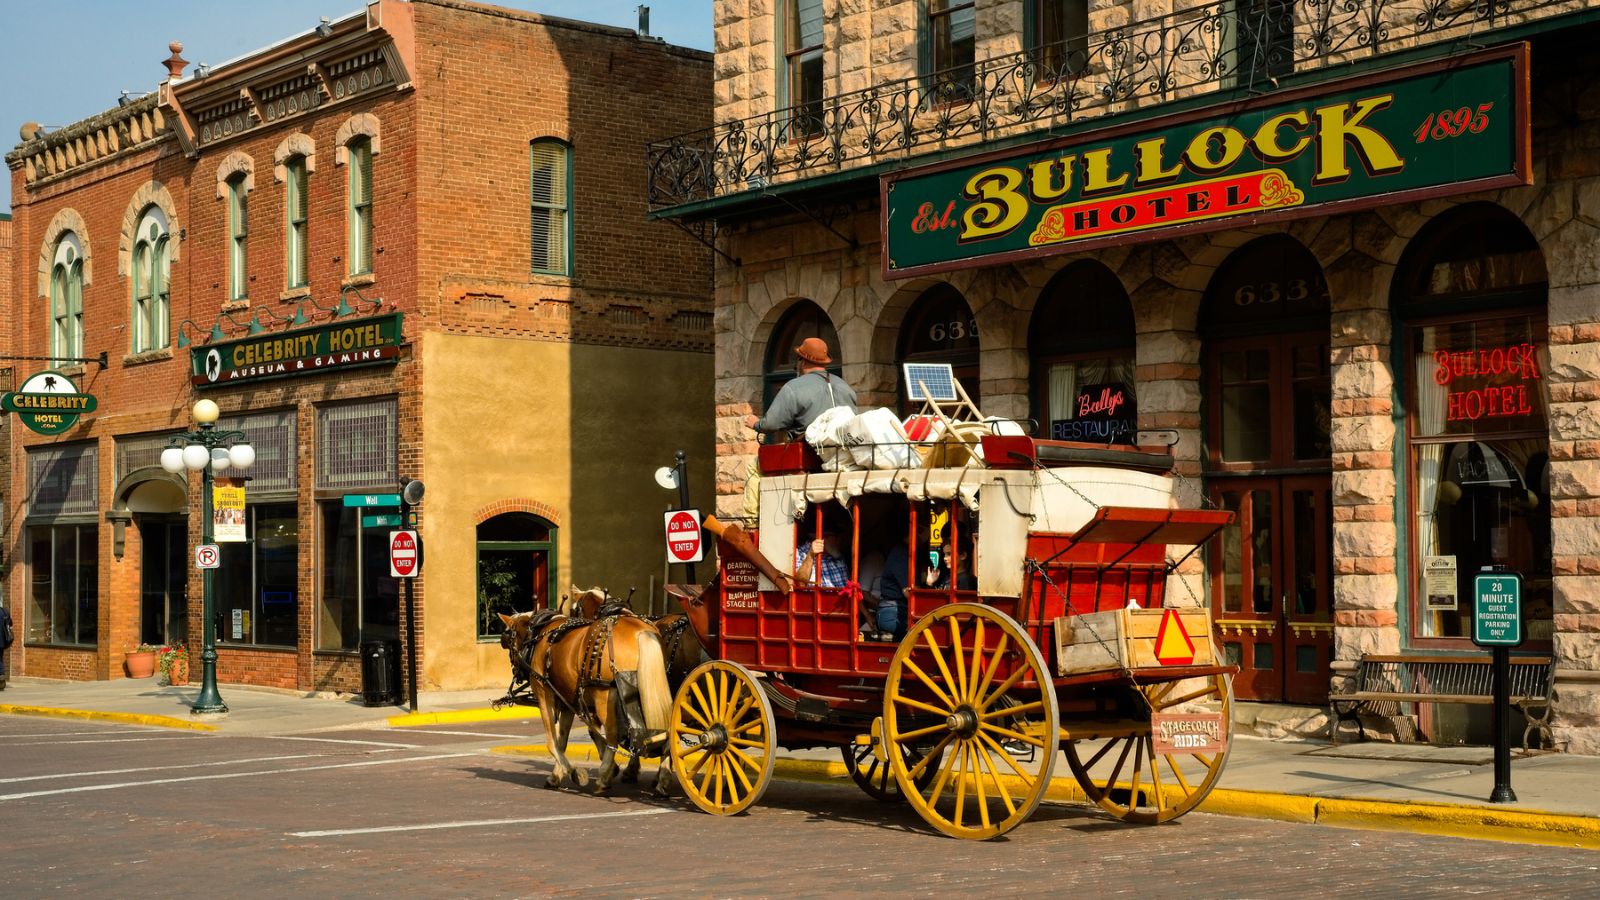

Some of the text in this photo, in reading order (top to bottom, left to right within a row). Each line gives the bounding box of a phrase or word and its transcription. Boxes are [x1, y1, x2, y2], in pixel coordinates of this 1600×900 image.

[911, 94, 1494, 246] Est. BULLOCK 1895
[1073, 185, 1250, 231] HOTEL
[233, 333, 320, 367] CELEBRITY
[330, 324, 384, 352] HOTEL
[230, 349, 381, 379] MUSEUM & GAMING
[1432, 343, 1540, 385] BULLOCK
[12, 394, 88, 409] CELEBRITY
[1447, 385, 1532, 420] HOTEL
[34, 414, 63, 423] HOTEL
[365, 496, 378, 505] Wall
[670, 521, 694, 530] DO NOT
[675, 543, 694, 551] ENTER
[1492, 582, 1503, 592] 20
[728, 591, 758, 600] BLACK HILLS
[1481, 594, 1514, 603] MINUTE
[726, 600, 746, 608] STAGE
[1160, 720, 1220, 742] STAGECOACH
[1173, 734, 1207, 748] RIDES
